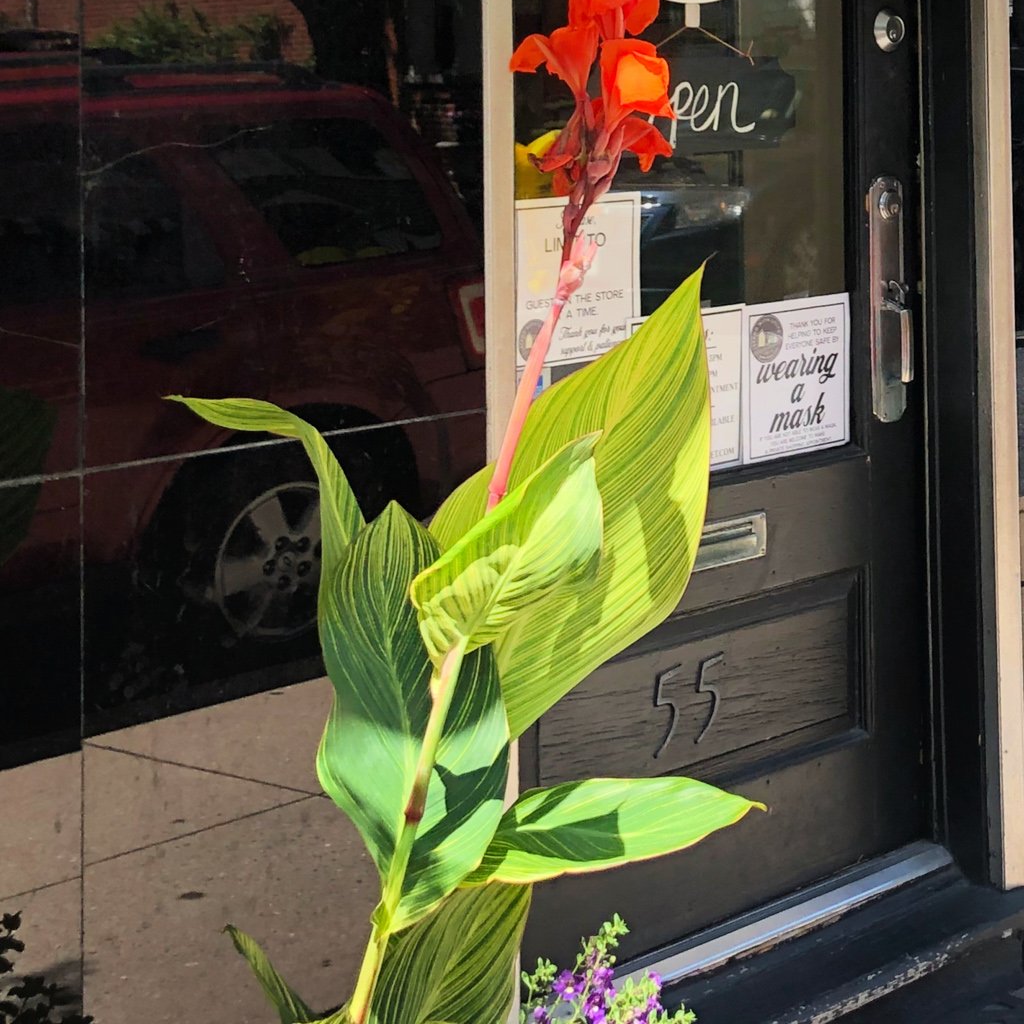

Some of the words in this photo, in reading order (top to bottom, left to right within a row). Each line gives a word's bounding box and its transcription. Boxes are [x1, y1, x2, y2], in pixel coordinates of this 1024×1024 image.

[648, 81, 756, 149] pen
[586, 232, 607, 247] TO
[575, 293, 592, 304] THE
[595, 289, 625, 301] STORE
[756, 347, 839, 385] wearing
[790, 383, 805, 404] a
[769, 392, 826, 434] mask
[652, 650, 726, 760] 55
